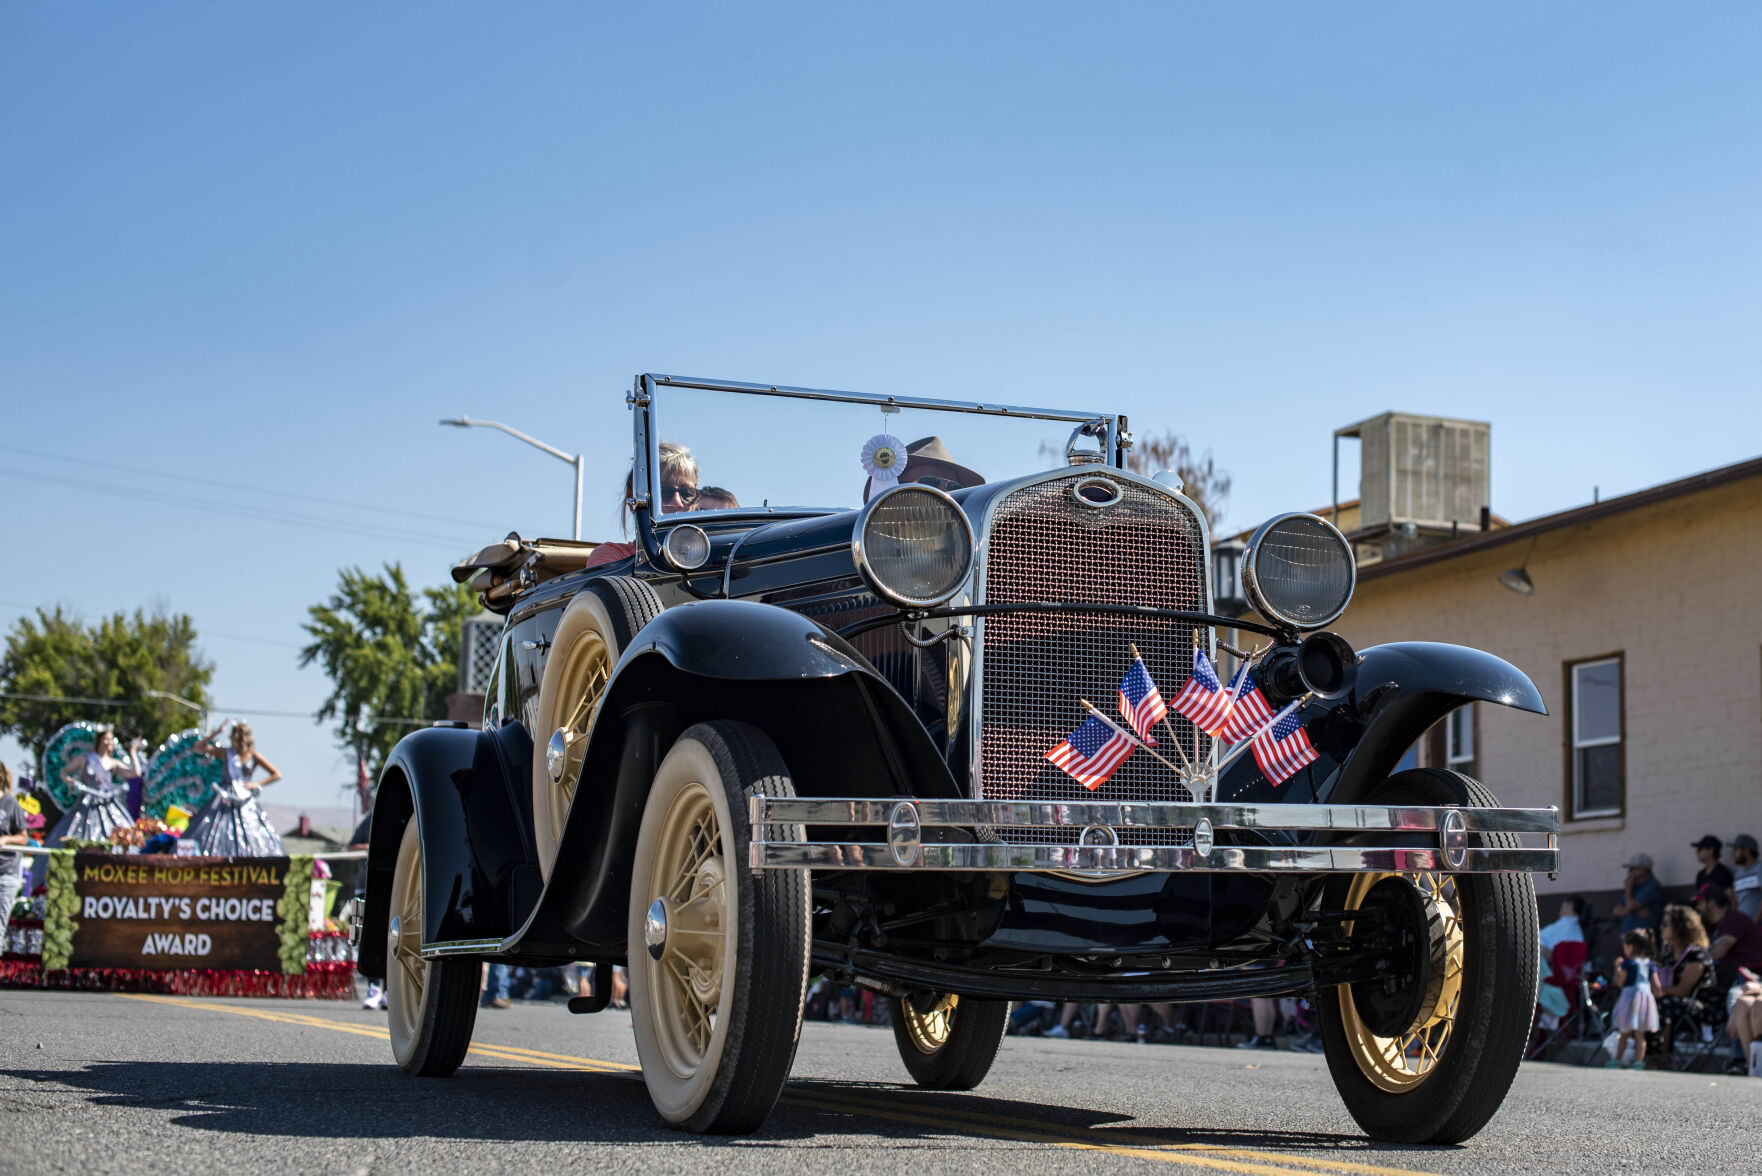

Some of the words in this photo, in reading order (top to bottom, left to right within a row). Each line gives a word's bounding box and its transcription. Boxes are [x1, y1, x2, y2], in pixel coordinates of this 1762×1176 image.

[84, 865, 148, 884] MOXEE
[154, 866, 195, 885] HOP
[201, 866, 280, 886] FESTIVAL
[84, 896, 192, 920] ROYALTY'S
[196, 898, 274, 921] CHOICE
[141, 933, 212, 956] AWARD
